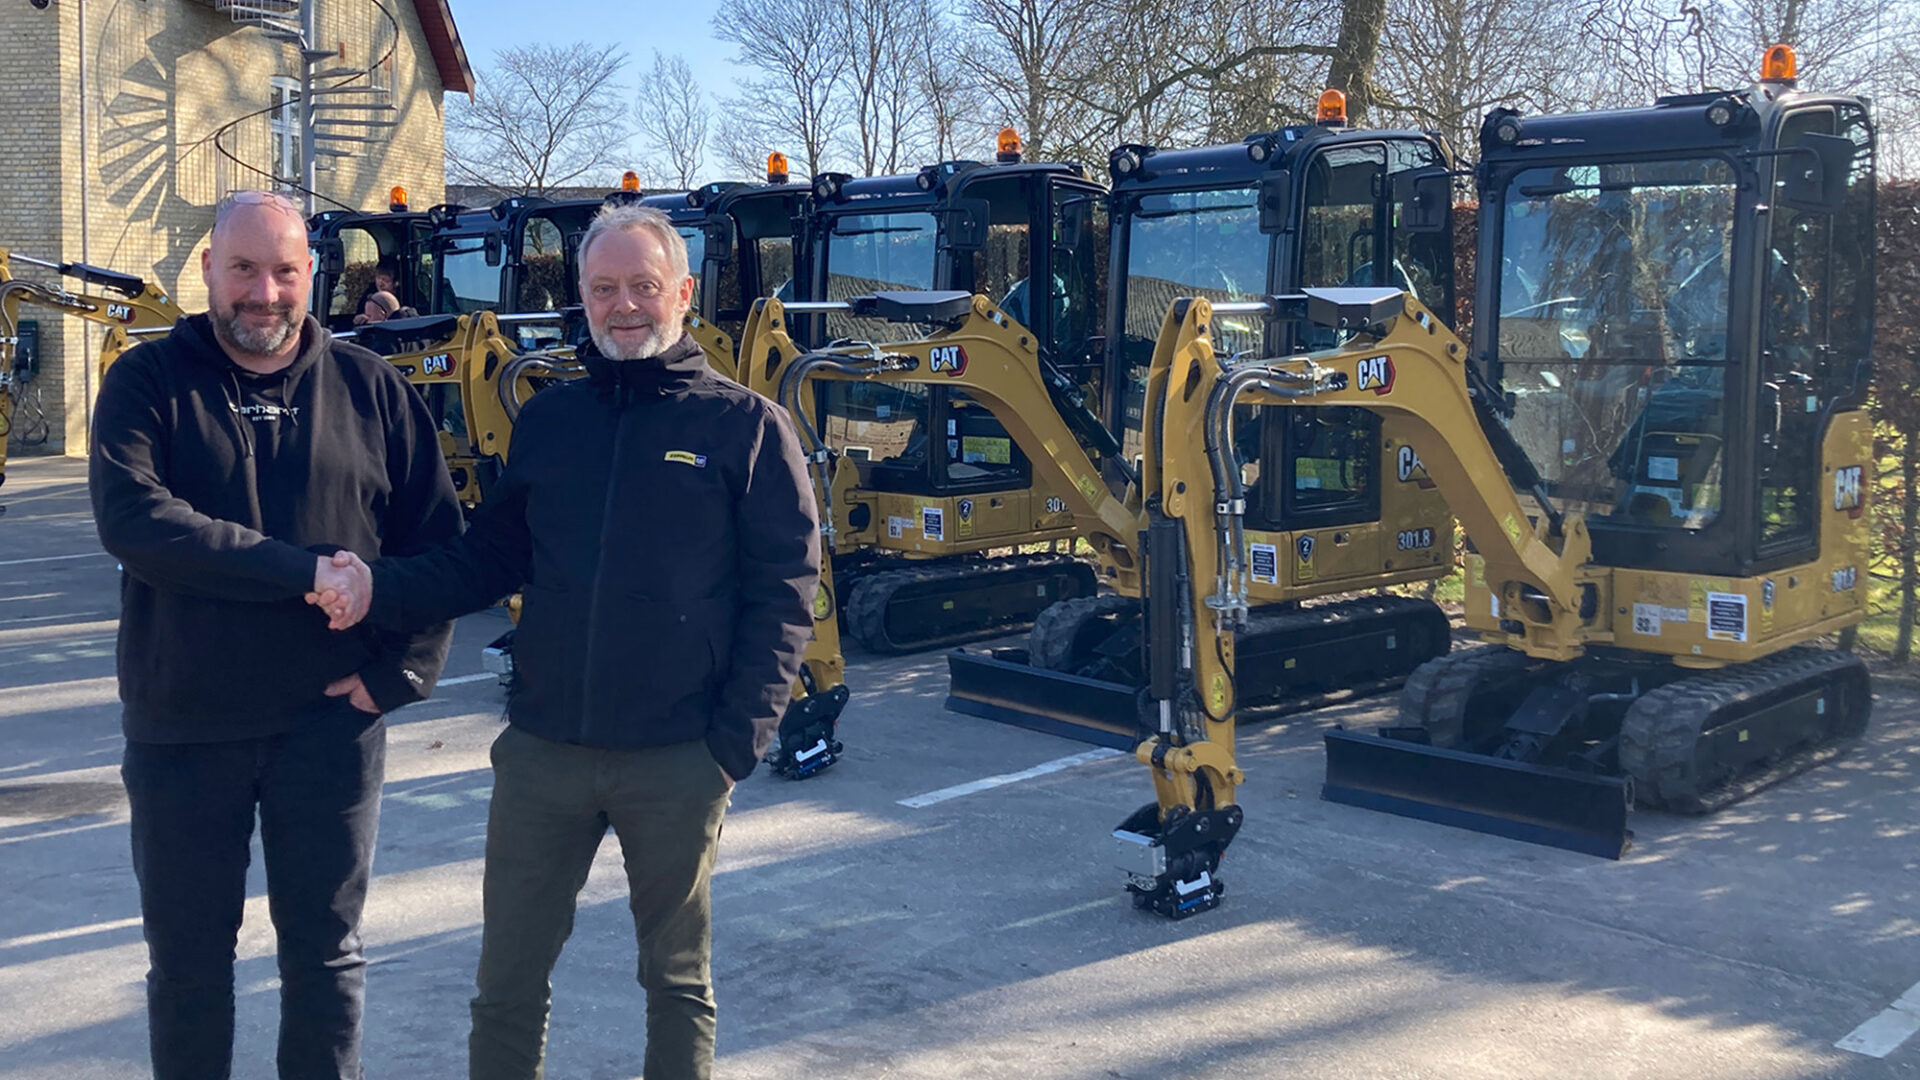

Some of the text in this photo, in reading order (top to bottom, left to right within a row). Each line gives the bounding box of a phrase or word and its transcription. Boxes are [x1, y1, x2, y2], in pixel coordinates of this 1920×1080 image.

[107, 304, 130, 320] CAT
[423, 354, 447, 375] CAT
[930, 346, 959, 372] CAT
[1358, 356, 1386, 390] CAT
[1398, 446, 1430, 481] CA
[1835, 466, 1861, 511] CAT
[962, 503, 969, 513] 2
[1303, 540, 1310, 553] 2
[1398, 529, 1430, 550] 301.8
